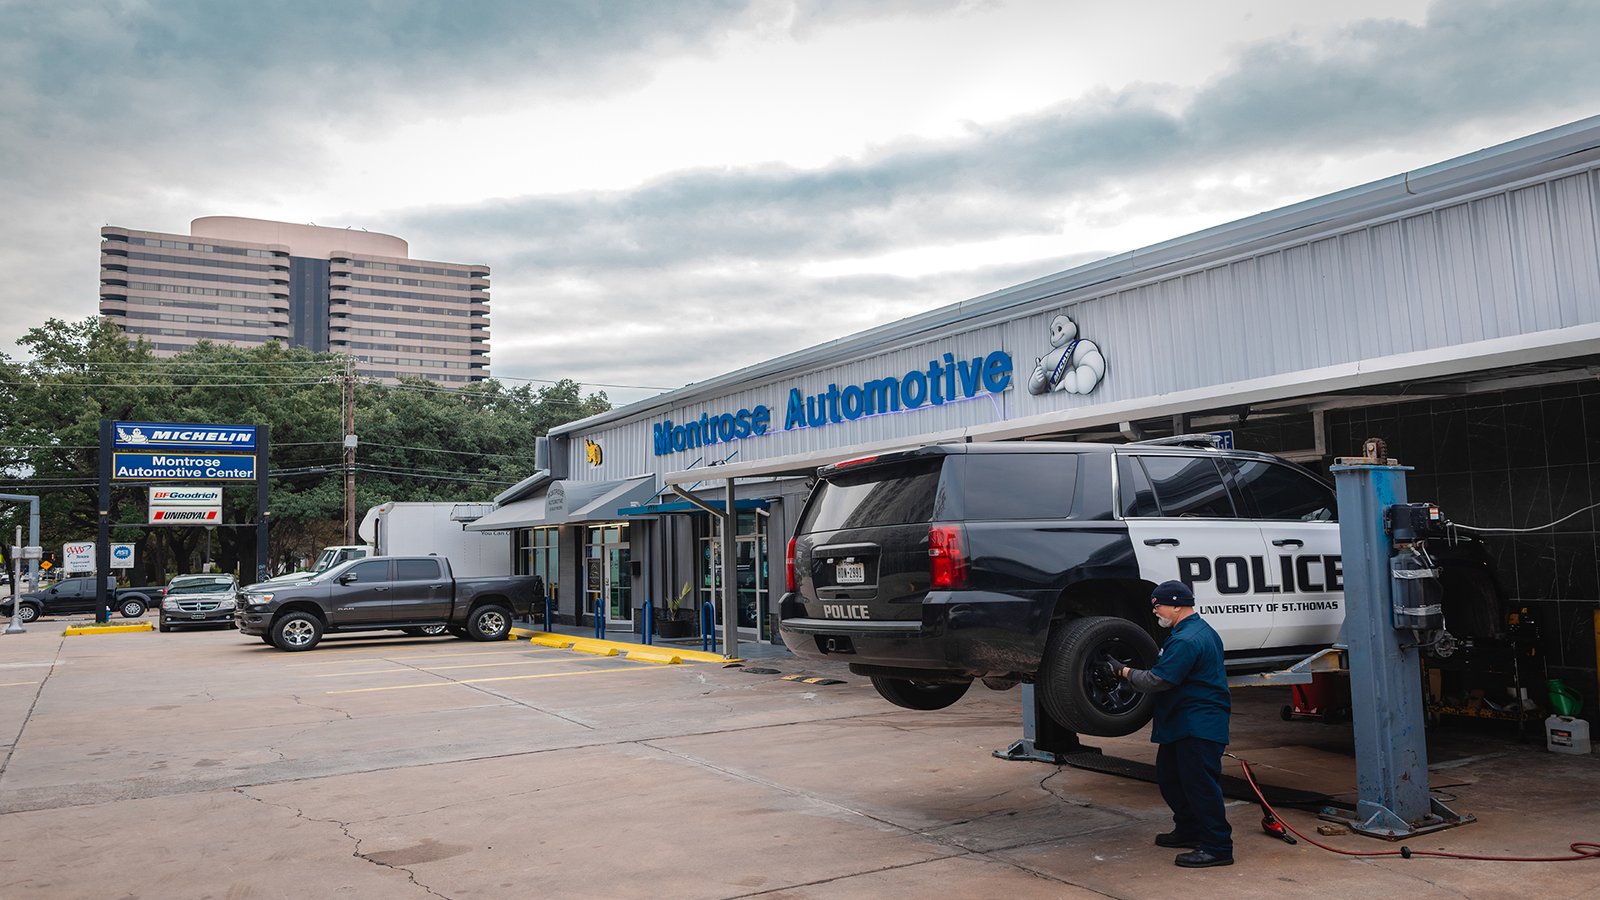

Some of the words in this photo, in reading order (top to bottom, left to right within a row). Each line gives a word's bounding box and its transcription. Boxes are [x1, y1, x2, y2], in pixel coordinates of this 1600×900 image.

[1054, 341, 1078, 382] MICHELIN
[653, 404, 771, 456] Montrose
[784, 350, 1014, 431] Automotive
[151, 430, 252, 442] MICHELIN
[152, 456, 221, 467] Montrose
[117, 466, 202, 477] Automotive
[205, 468, 253, 478] Center
[164, 511, 206, 520] UNIROYAL
[1177, 554, 1345, 595] POLICE
[823, 604, 870, 620] POLICE
[1199, 603, 1263, 615] UNIVERSITY
[1266, 603, 1279, 612] OF
[1282, 601, 1339, 612] ST.THOMAS
